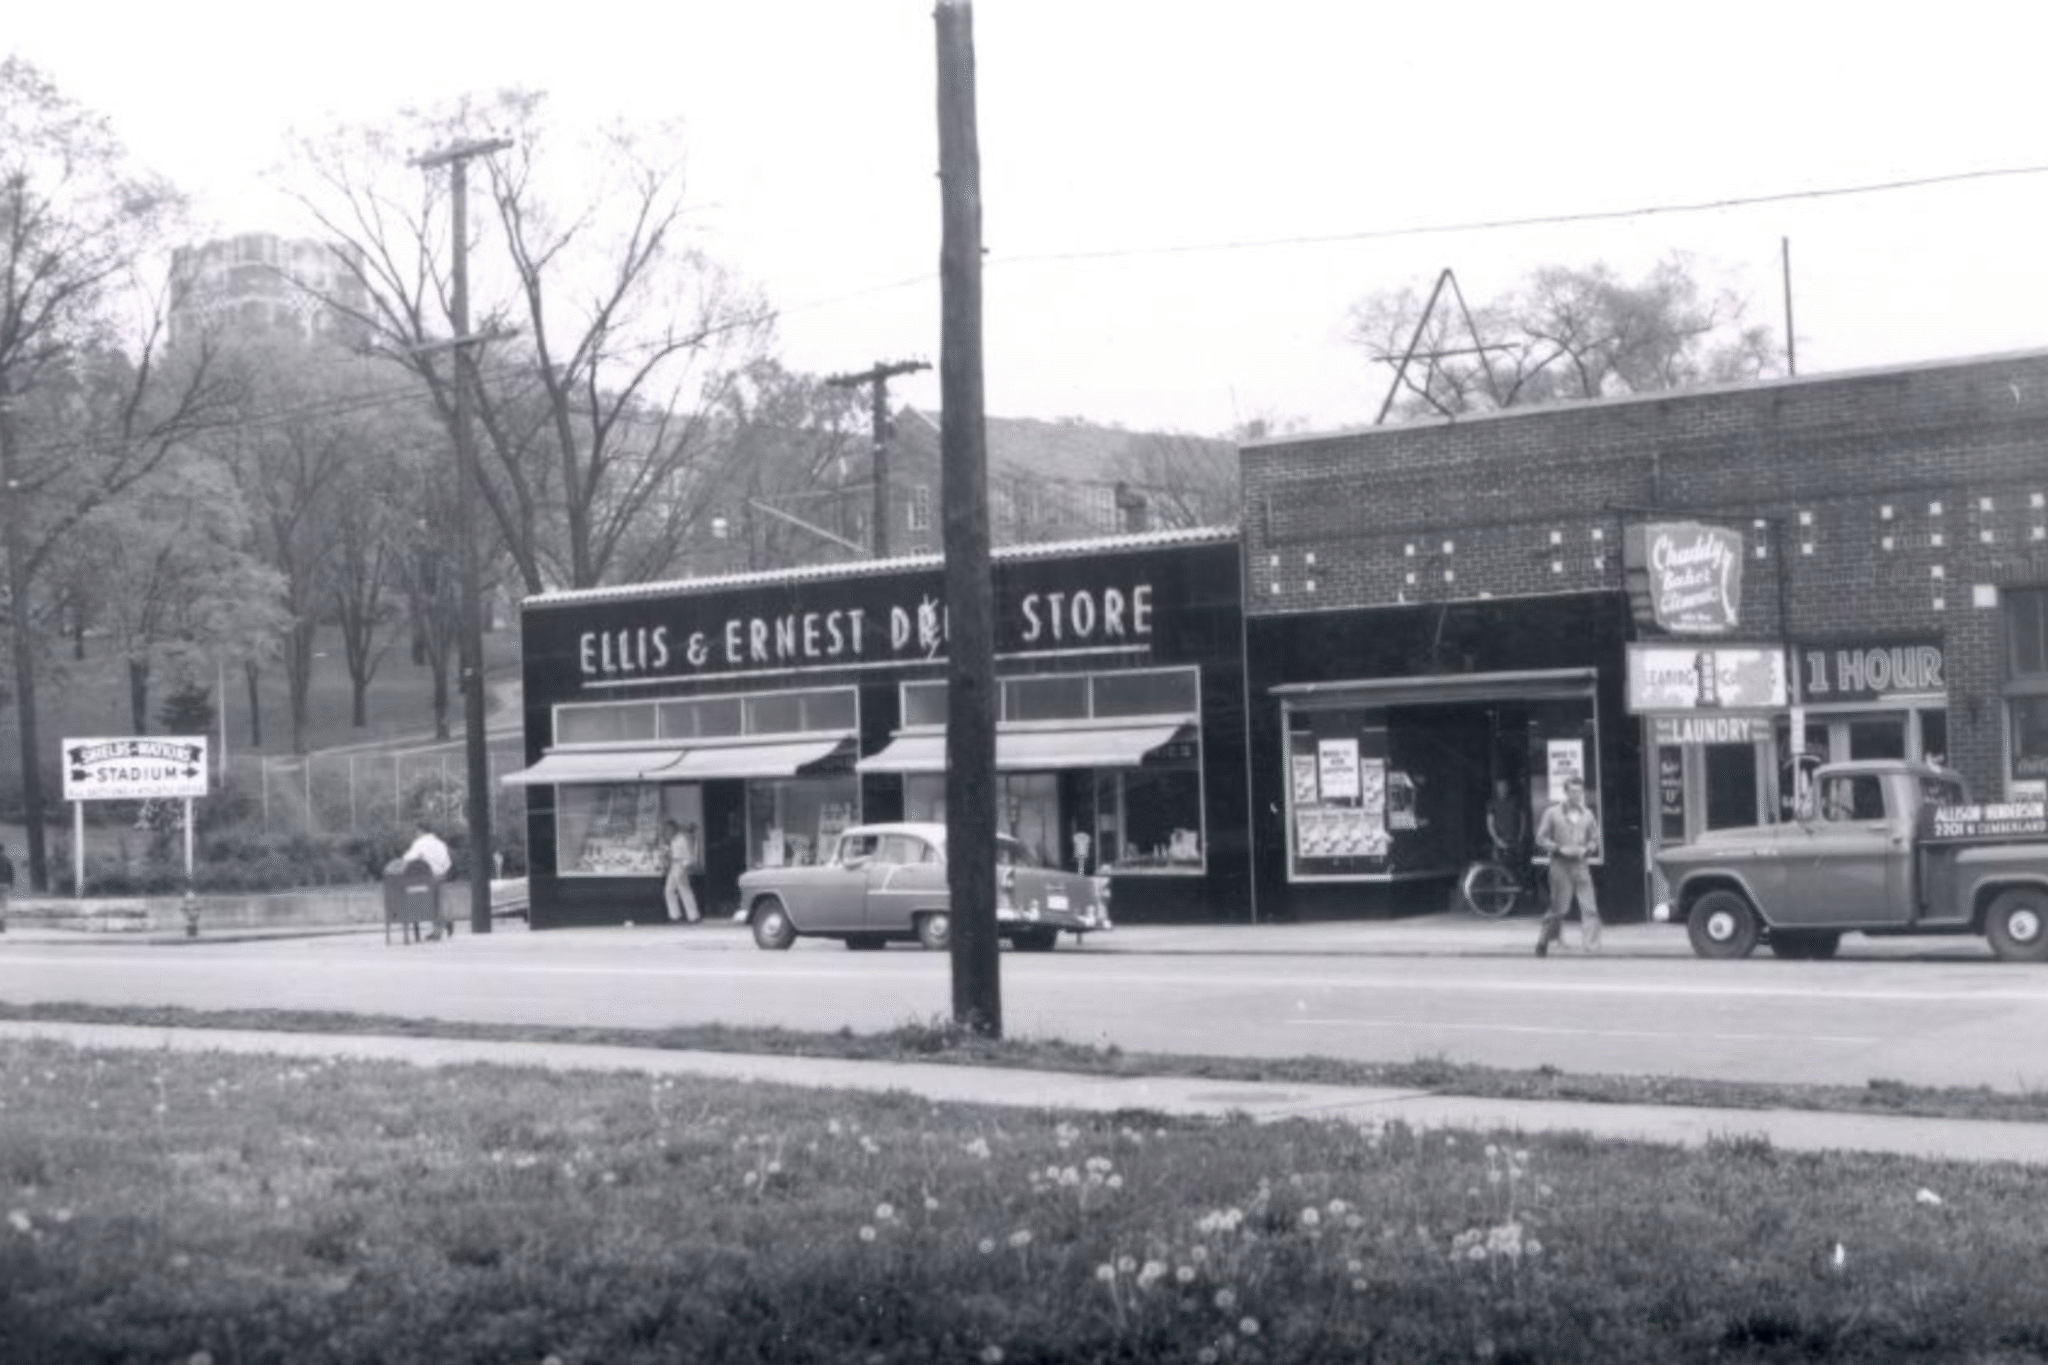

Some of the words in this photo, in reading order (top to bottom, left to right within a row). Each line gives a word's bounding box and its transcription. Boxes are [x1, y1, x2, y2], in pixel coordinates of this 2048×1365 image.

[580, 626, 668, 674] ELLIS
[687, 632, 708, 665] &
[725, 609, 865, 663] ERNEST
[1021, 584, 1153, 641] STORE
[1806, 651, 1830, 692] 1
[1837, 645, 1944, 691] HOUR
[1673, 718, 1751, 743] LAUNDRY
[97, 766, 178, 783] STADIUM
